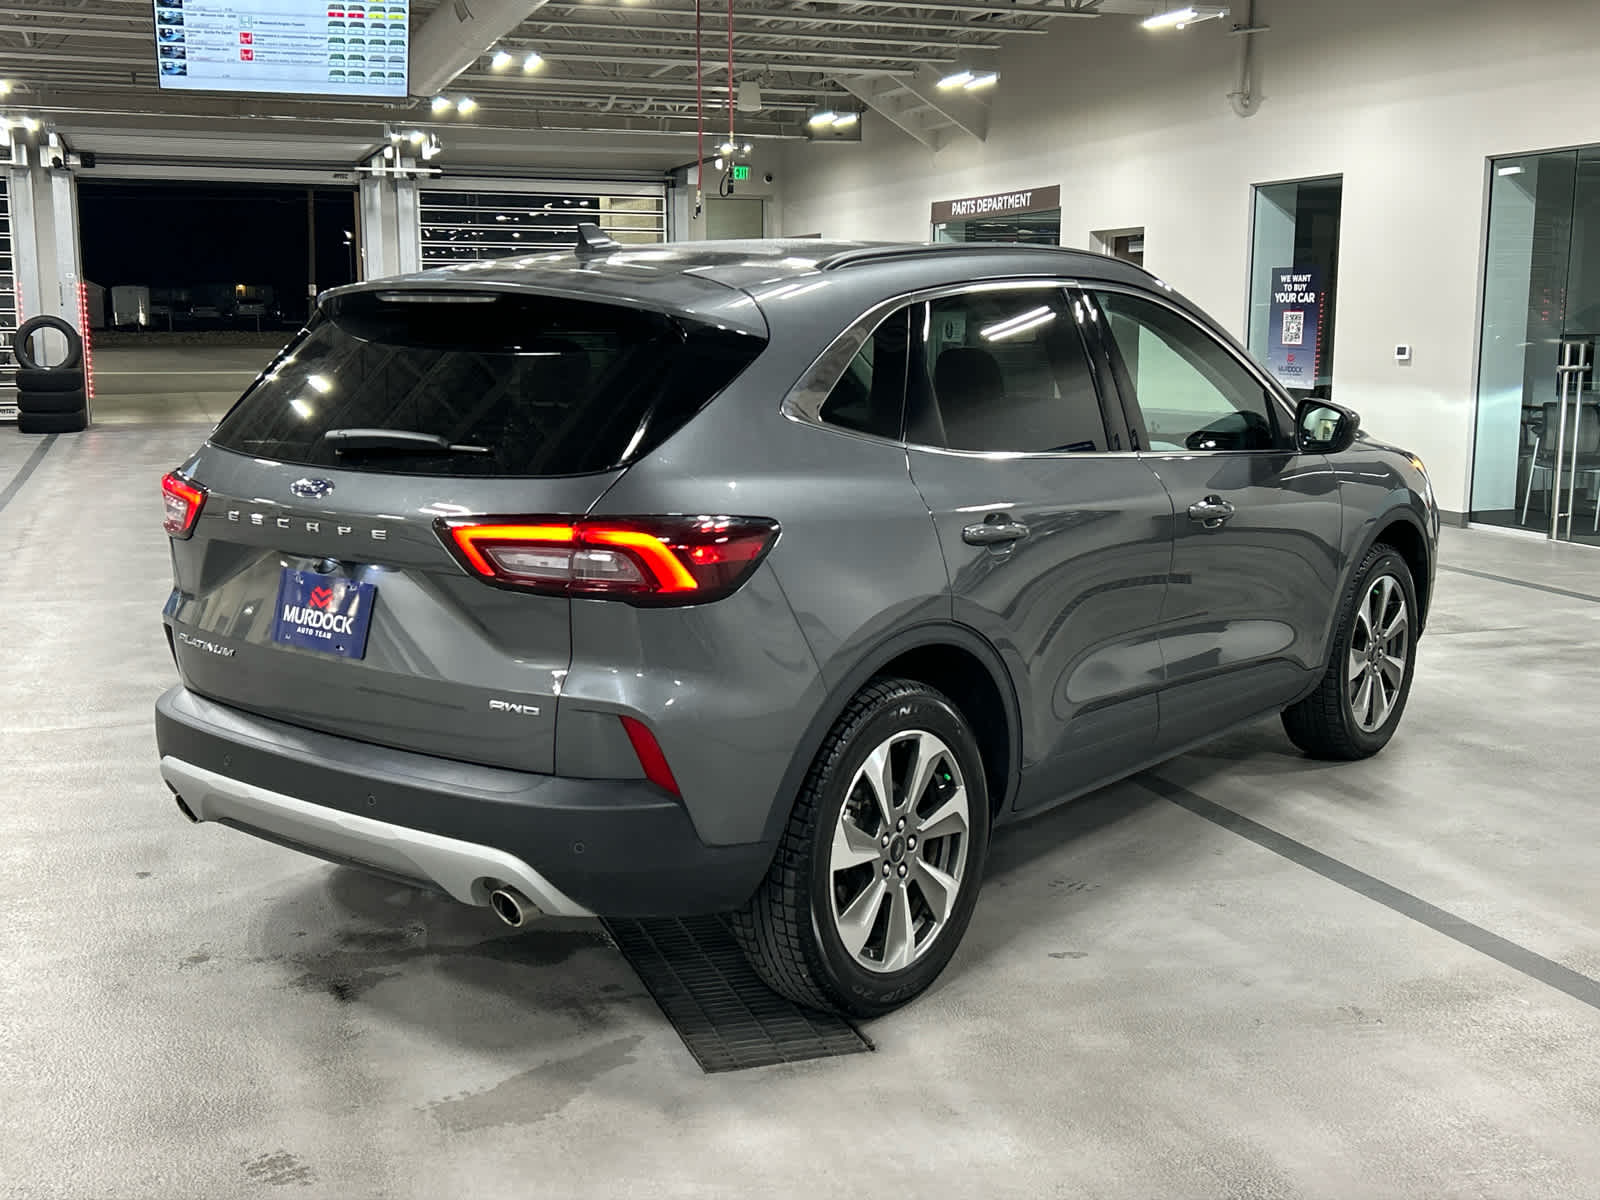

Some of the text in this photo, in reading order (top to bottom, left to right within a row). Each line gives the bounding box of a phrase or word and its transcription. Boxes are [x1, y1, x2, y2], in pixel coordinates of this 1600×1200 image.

[951, 192, 1032, 216] PARTS DEPARTMENT
[1280, 274, 1312, 283] WE WANT
[1283, 283, 1307, 291] TO BUY
[1274, 292, 1316, 303] YOUR CAR
[228, 510, 387, 540] ESCAPE
[283, 604, 354, 635] MURDOCK
[296, 626, 332, 639] AUTO TEAM
[178, 632, 236, 657] PLATINUM
